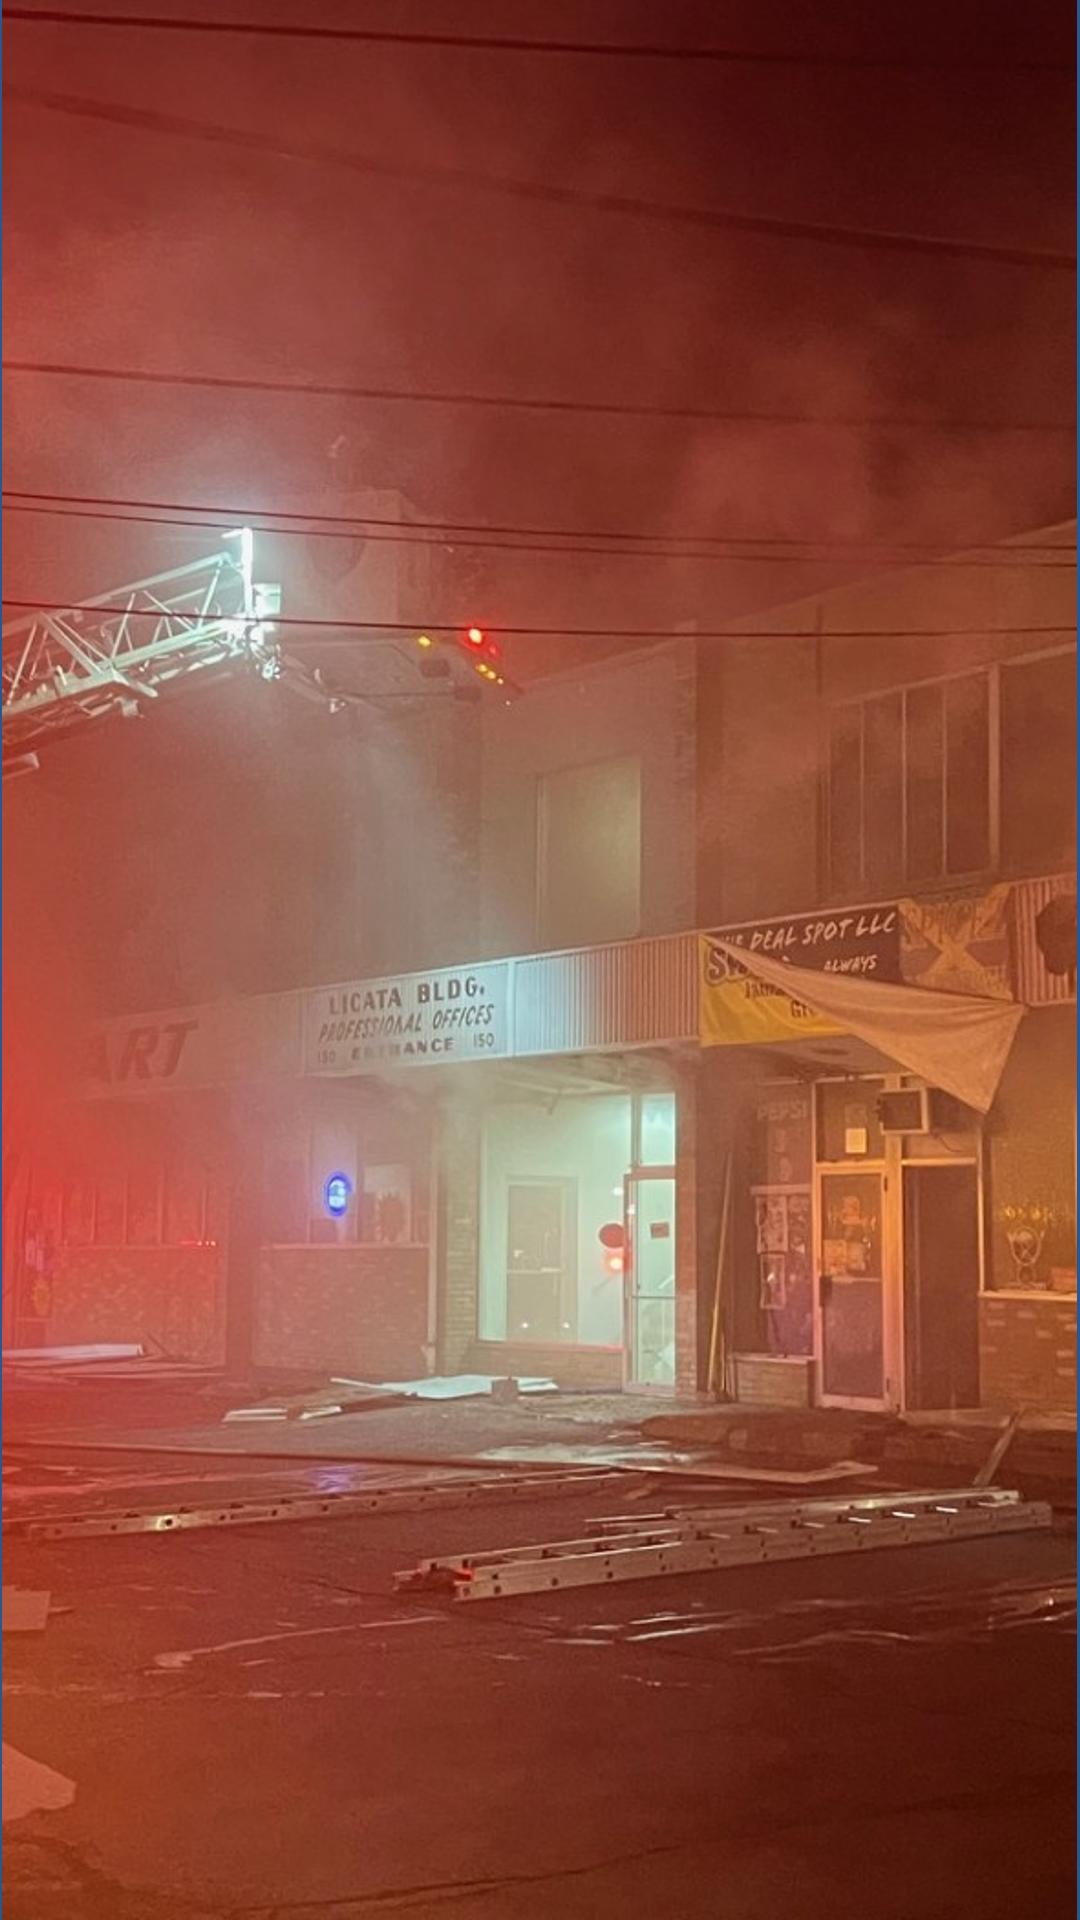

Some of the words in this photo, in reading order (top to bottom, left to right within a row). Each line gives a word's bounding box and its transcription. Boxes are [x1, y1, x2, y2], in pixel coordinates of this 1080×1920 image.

[750, 926, 797, 951] DEAL
[802, 918, 854, 945] SPOT
[856, 912, 895, 936] LLC
[823, 953, 878, 973] ALWAYS
[329, 987, 402, 1014] LICATA
[417, 976, 484, 1003] BLDG.
[318, 1014, 422, 1042] PROFESSIONAL
[432, 1004, 494, 1029] OFFICES
[472, 1032, 495, 1048] 150
[756, 1099, 807, 1121] PEPSI
